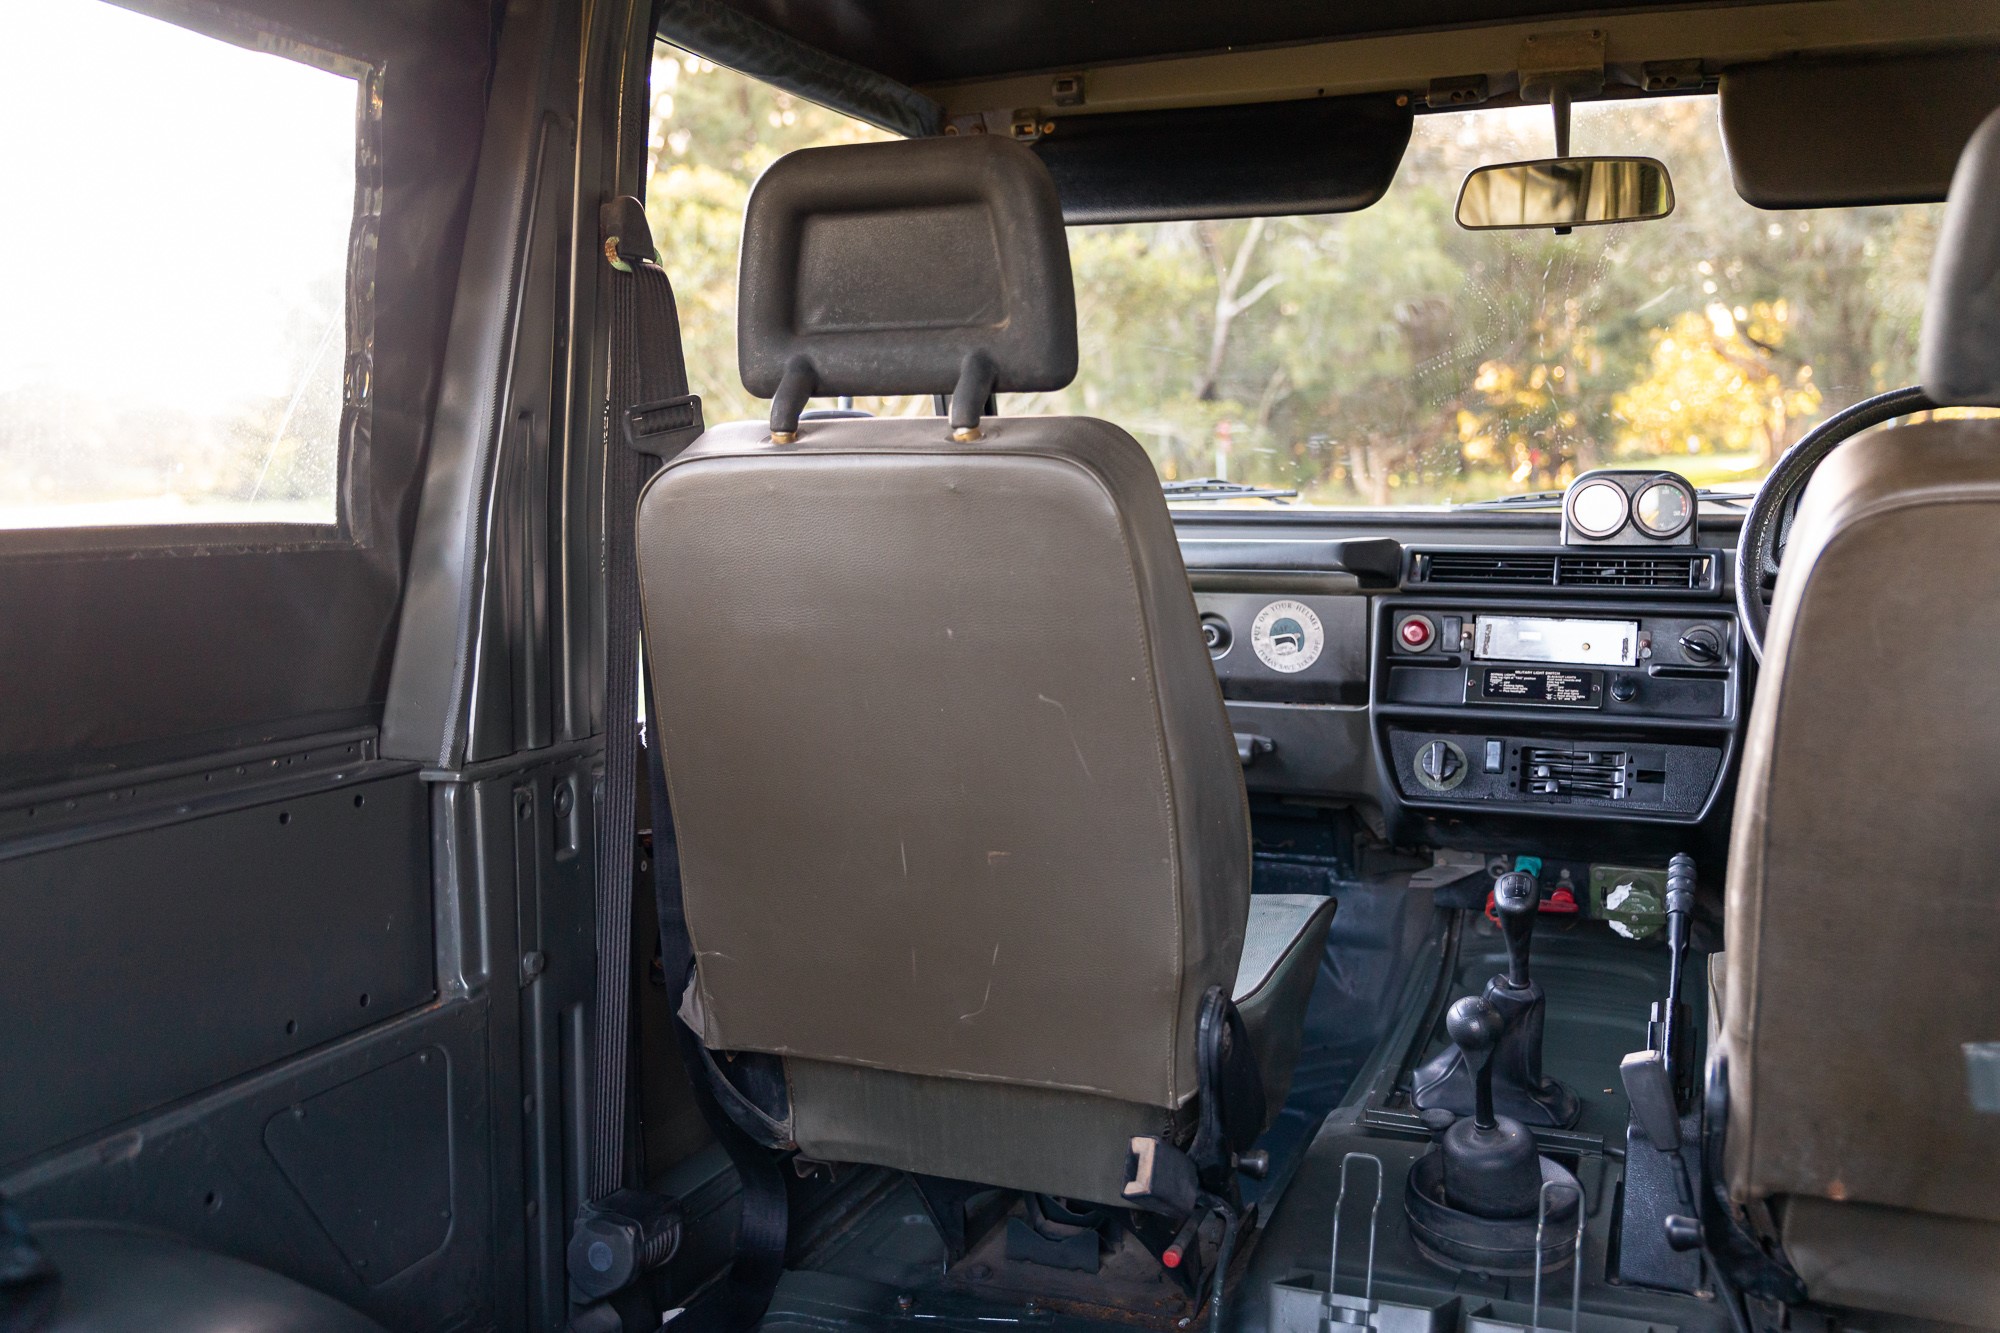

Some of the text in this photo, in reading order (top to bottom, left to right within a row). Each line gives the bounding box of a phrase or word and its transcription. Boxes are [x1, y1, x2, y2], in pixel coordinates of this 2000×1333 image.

[1259, 612, 1269, 623] ON
[1270, 602, 1292, 612] YOUR
[1296, 604, 1320, 631] HELMET
